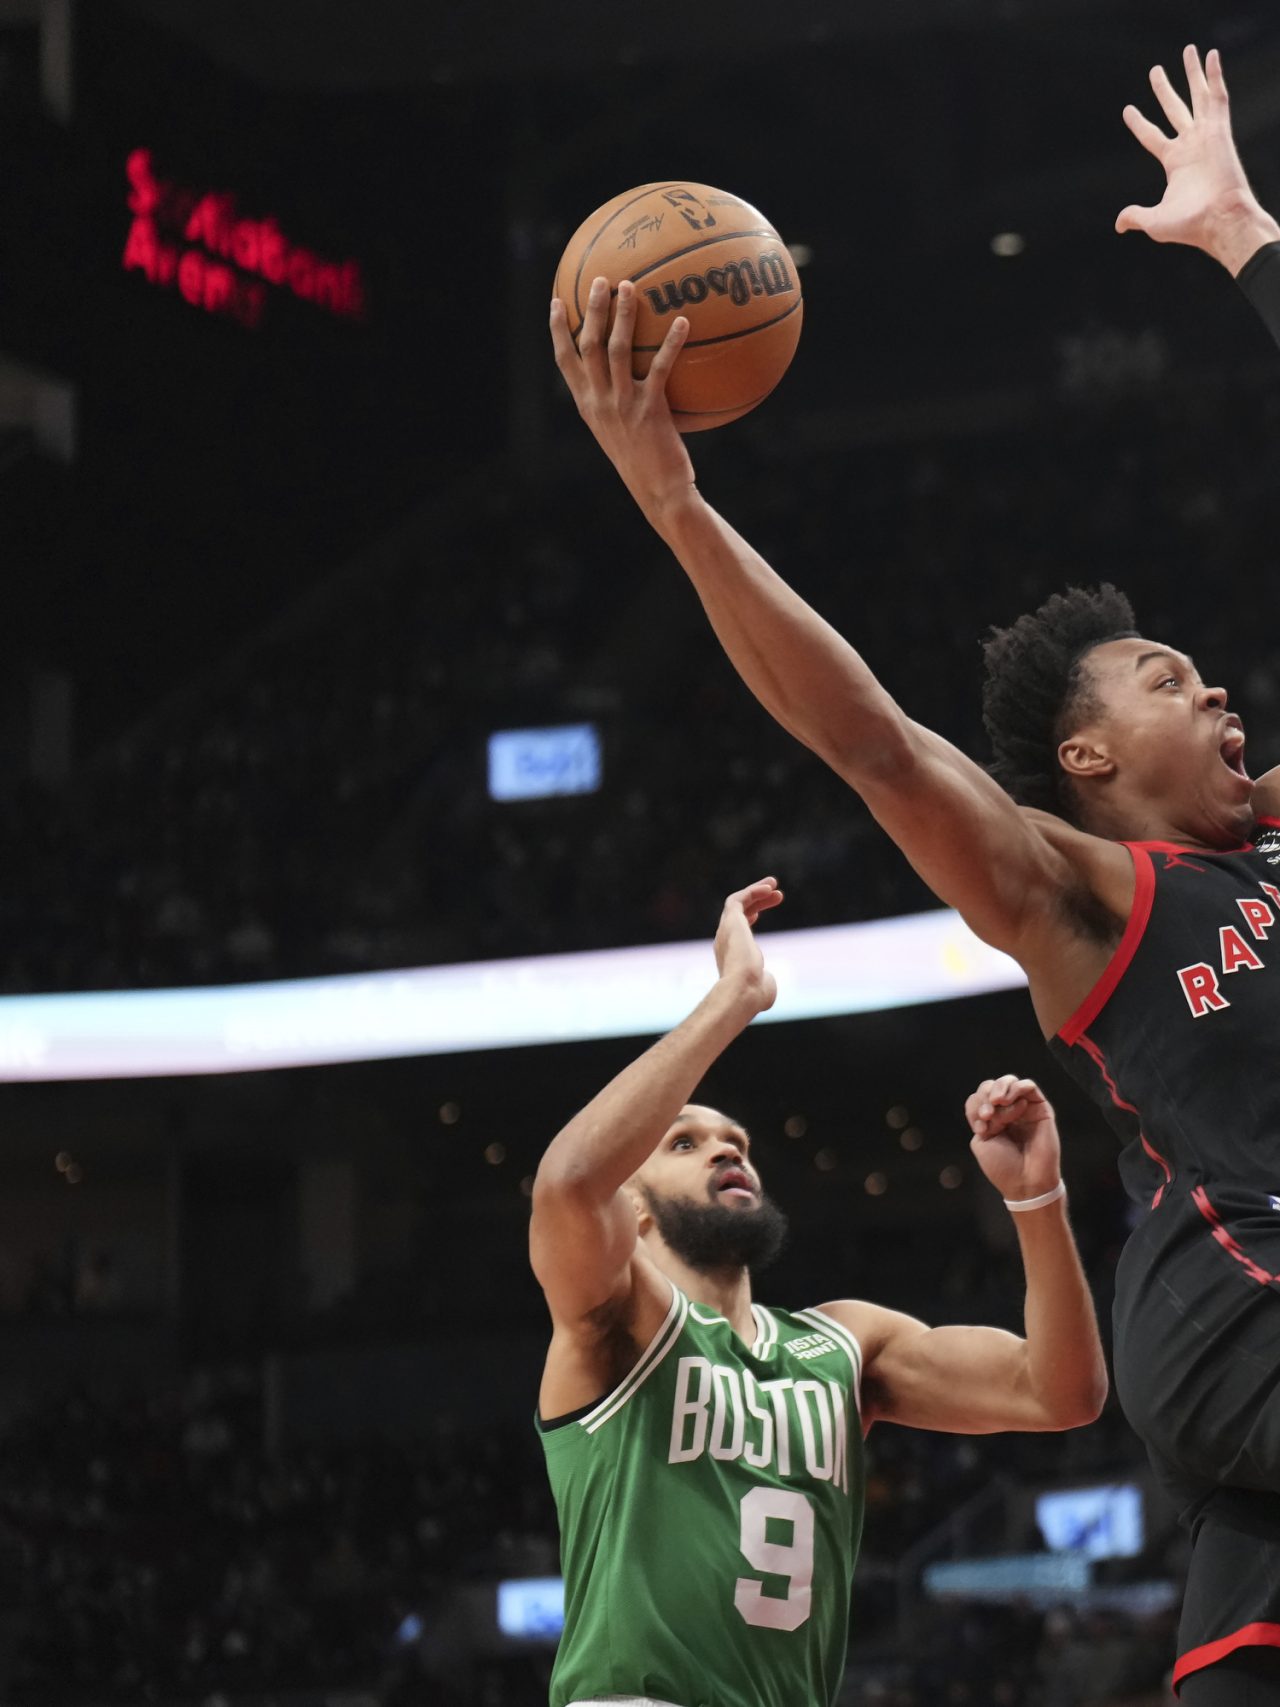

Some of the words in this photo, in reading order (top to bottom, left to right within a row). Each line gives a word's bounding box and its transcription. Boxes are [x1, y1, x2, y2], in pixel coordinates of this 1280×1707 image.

[122, 214, 264, 327] Aren
[646, 250, 795, 315] Wilson
[668, 1357, 848, 1496] BOSTON
[734, 1486, 814, 1631] 9
